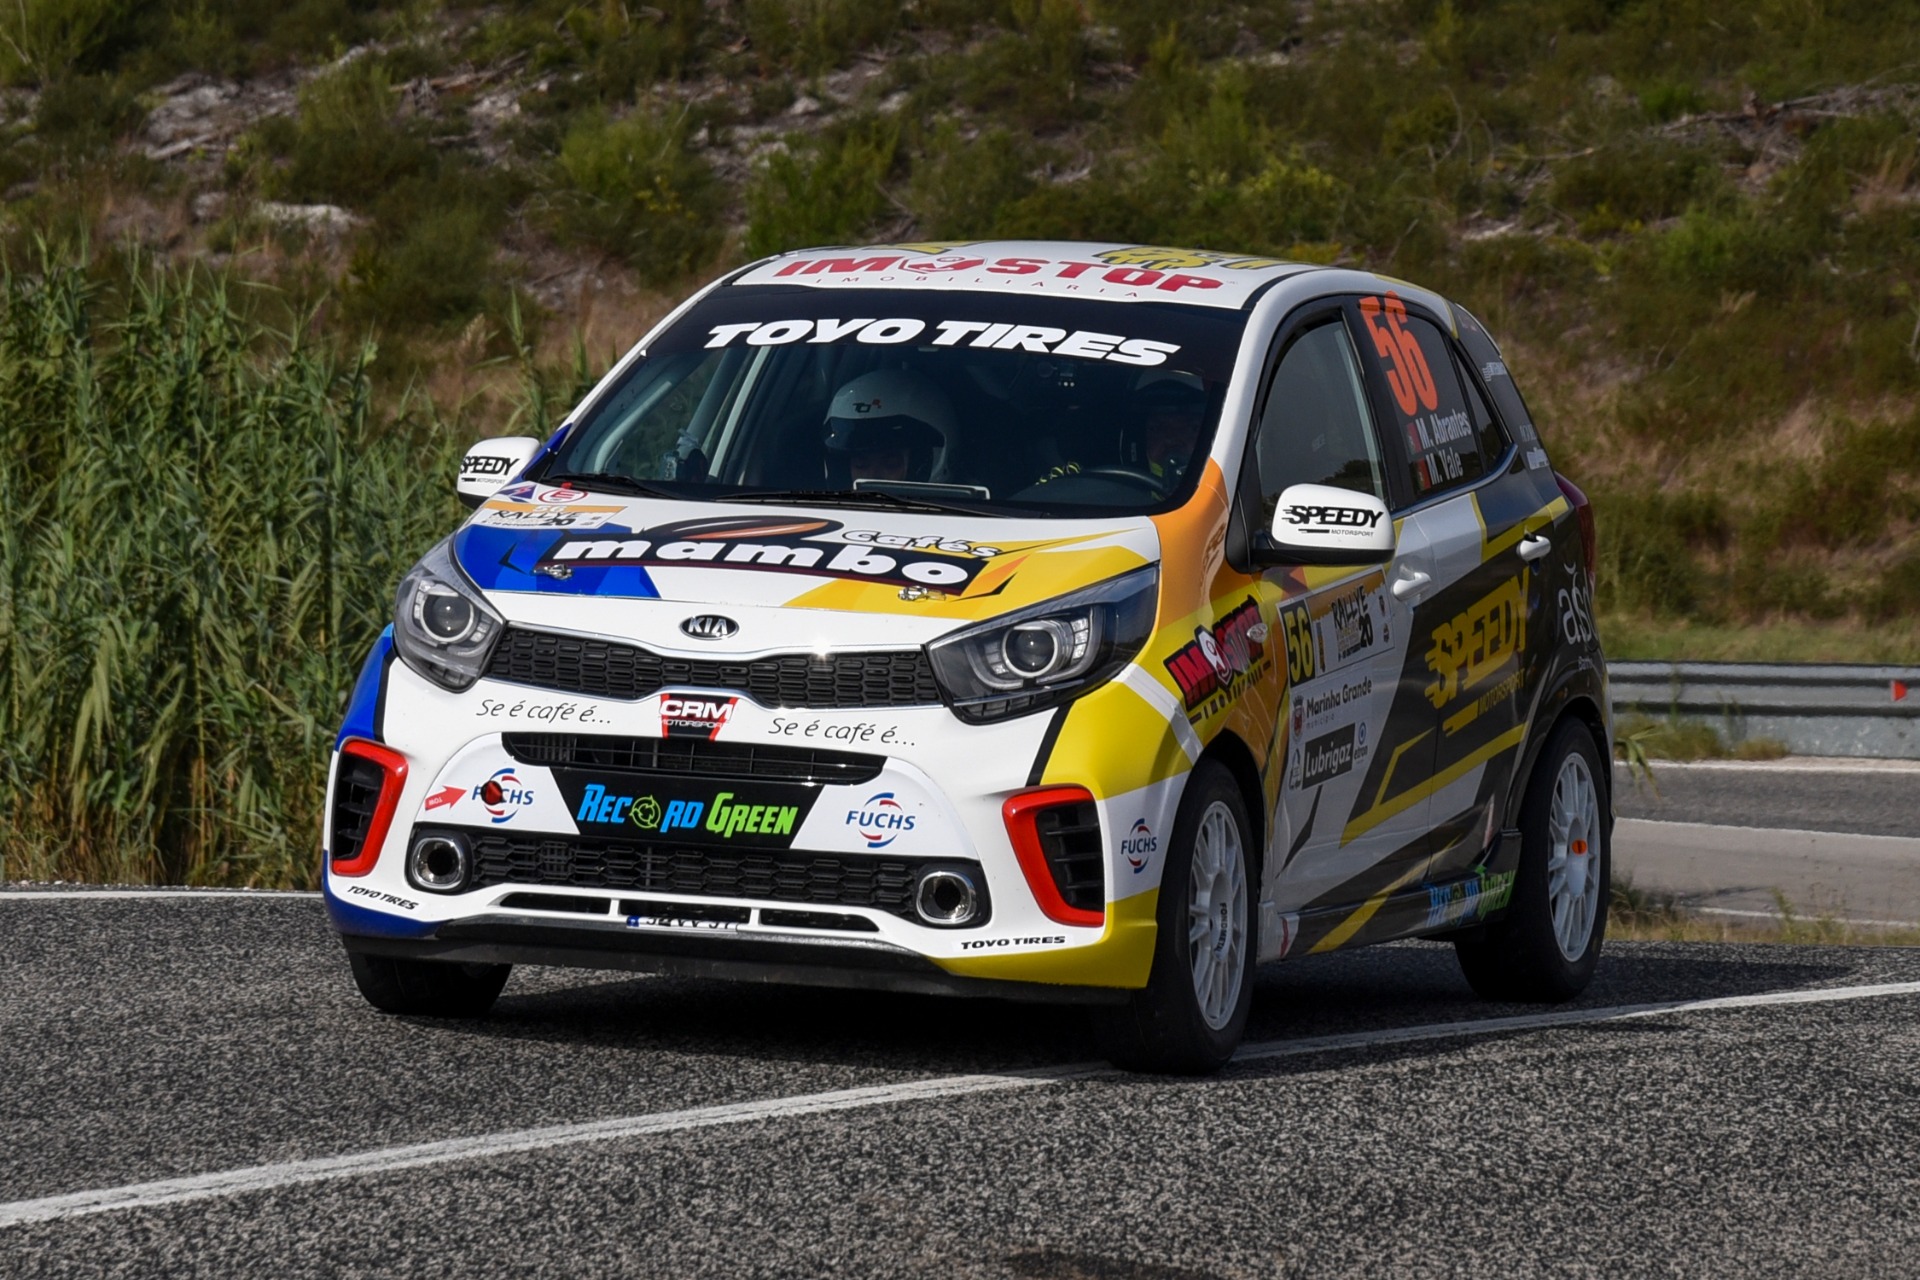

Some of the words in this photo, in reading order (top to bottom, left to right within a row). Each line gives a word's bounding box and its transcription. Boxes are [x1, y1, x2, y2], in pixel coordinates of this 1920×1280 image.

[703, 317, 926, 349] TOYO
[932, 320, 1181, 366] TIRES
[1359, 290, 1438, 416] 56
[1439, 447, 1464, 480] Vale
[1283, 505, 1385, 528] SPEEDY
[1330, 529, 1374, 537] MOTORSPORT
[553, 538, 969, 585] mambo
[686, 616, 728, 637] KIA
[1424, 566, 1530, 709] SPEEDY
[1283, 606, 1315, 682] 56
[660, 699, 734, 720] CRM
[1306, 690, 1341, 718] Marinha
[1342, 676, 1372, 704] Grande
[476, 699, 505, 717] Se
[509, 700, 526, 717] é
[527, 702, 578, 724] café
[768, 717, 799, 736] Se
[804, 719, 821, 737] é
[824, 723, 876, 745] café
[1305, 741, 1353, 780] Lubrigaz
[471, 784, 535, 806] FCHS
[845, 809, 916, 833] FUCHS
[1120, 836, 1158, 855] FUCHS
[347, 885, 382, 899] TOYO
[379, 894, 420, 910] TIRES
[961, 938, 1010, 950] TOYO
[1012, 936, 1066, 947] TIRES
